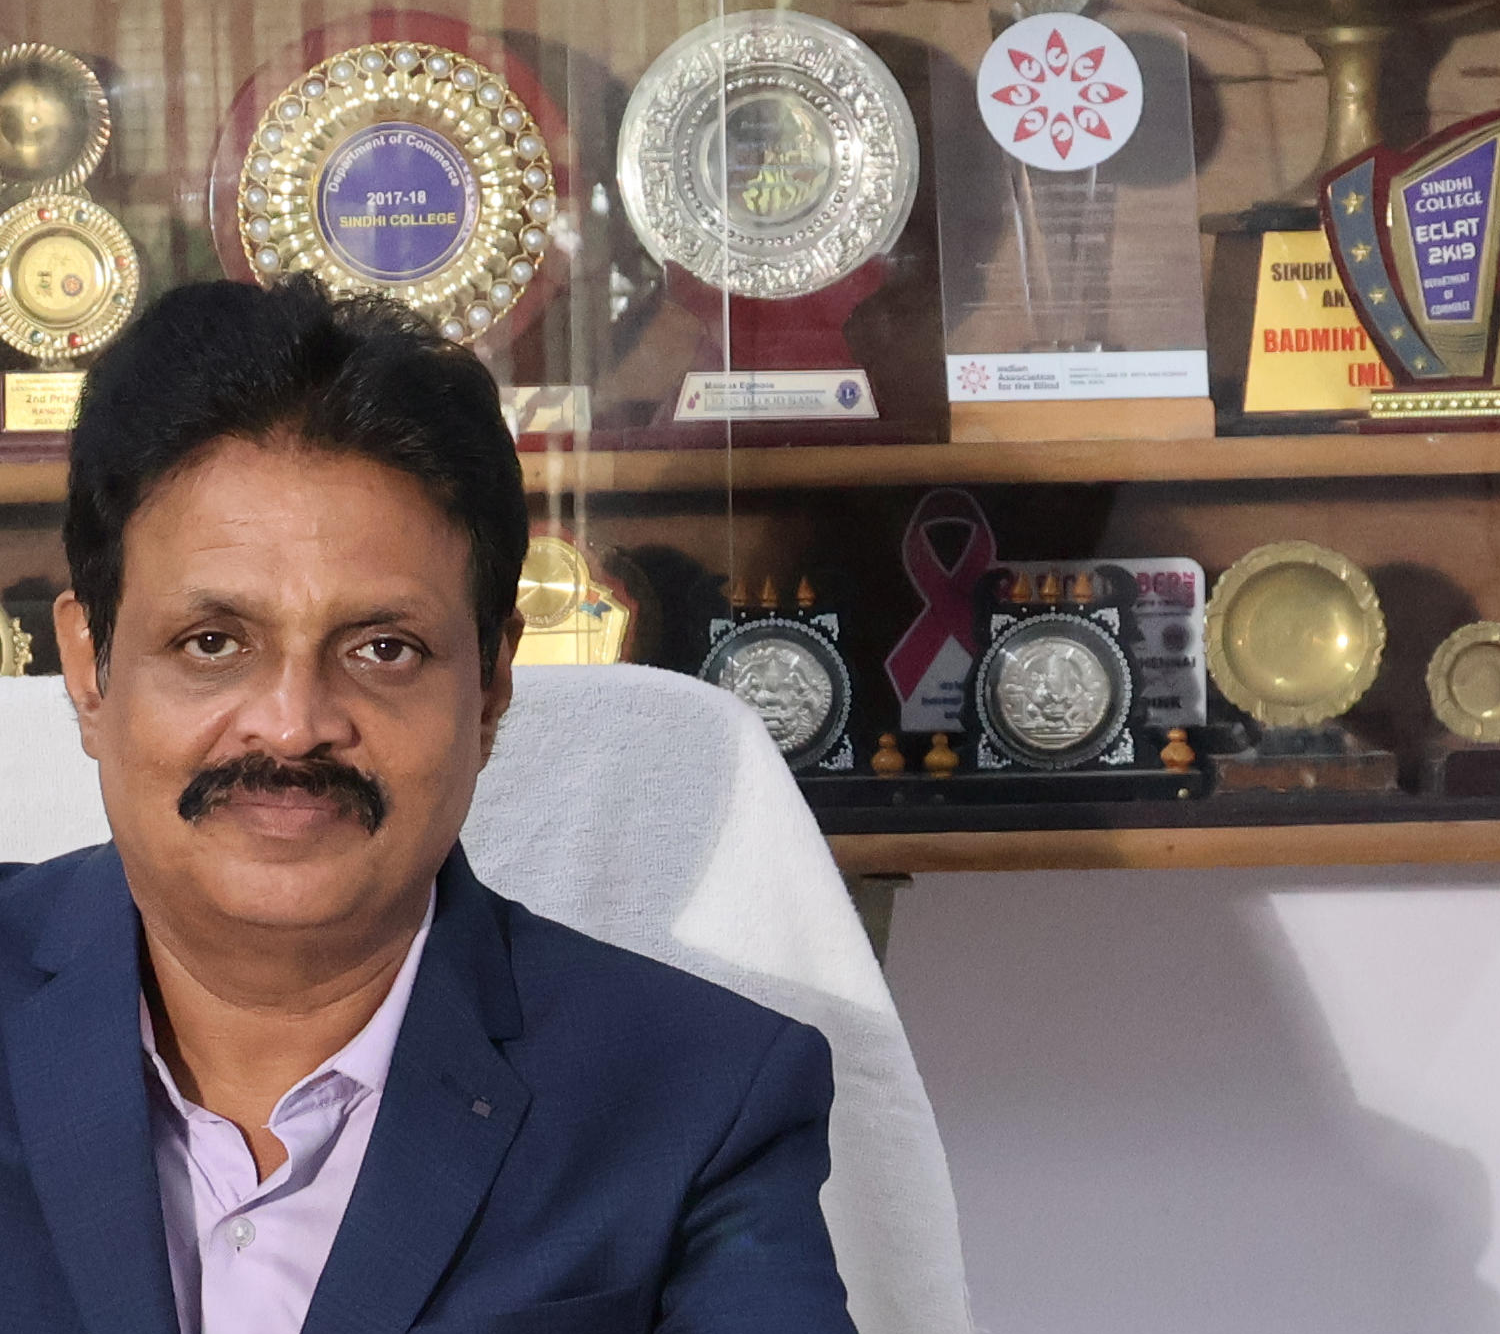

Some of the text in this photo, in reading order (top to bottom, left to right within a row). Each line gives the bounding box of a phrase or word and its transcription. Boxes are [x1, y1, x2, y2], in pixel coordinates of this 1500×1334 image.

[328, 133, 460, 193] Department of Commerce
[366, 189, 427, 206] 2017-18
[1420, 175, 1473, 197] SINDHI
[1414, 190, 1484, 214] COLLEGE
[340, 212, 457, 228] SINDHI COLLEGE
[1415, 217, 1481, 244] ECLAT
[1428, 241, 1477, 266] 2K19
[1271, 263, 1333, 282] SINDHI
[1263, 325, 1369, 354] BADMINT
